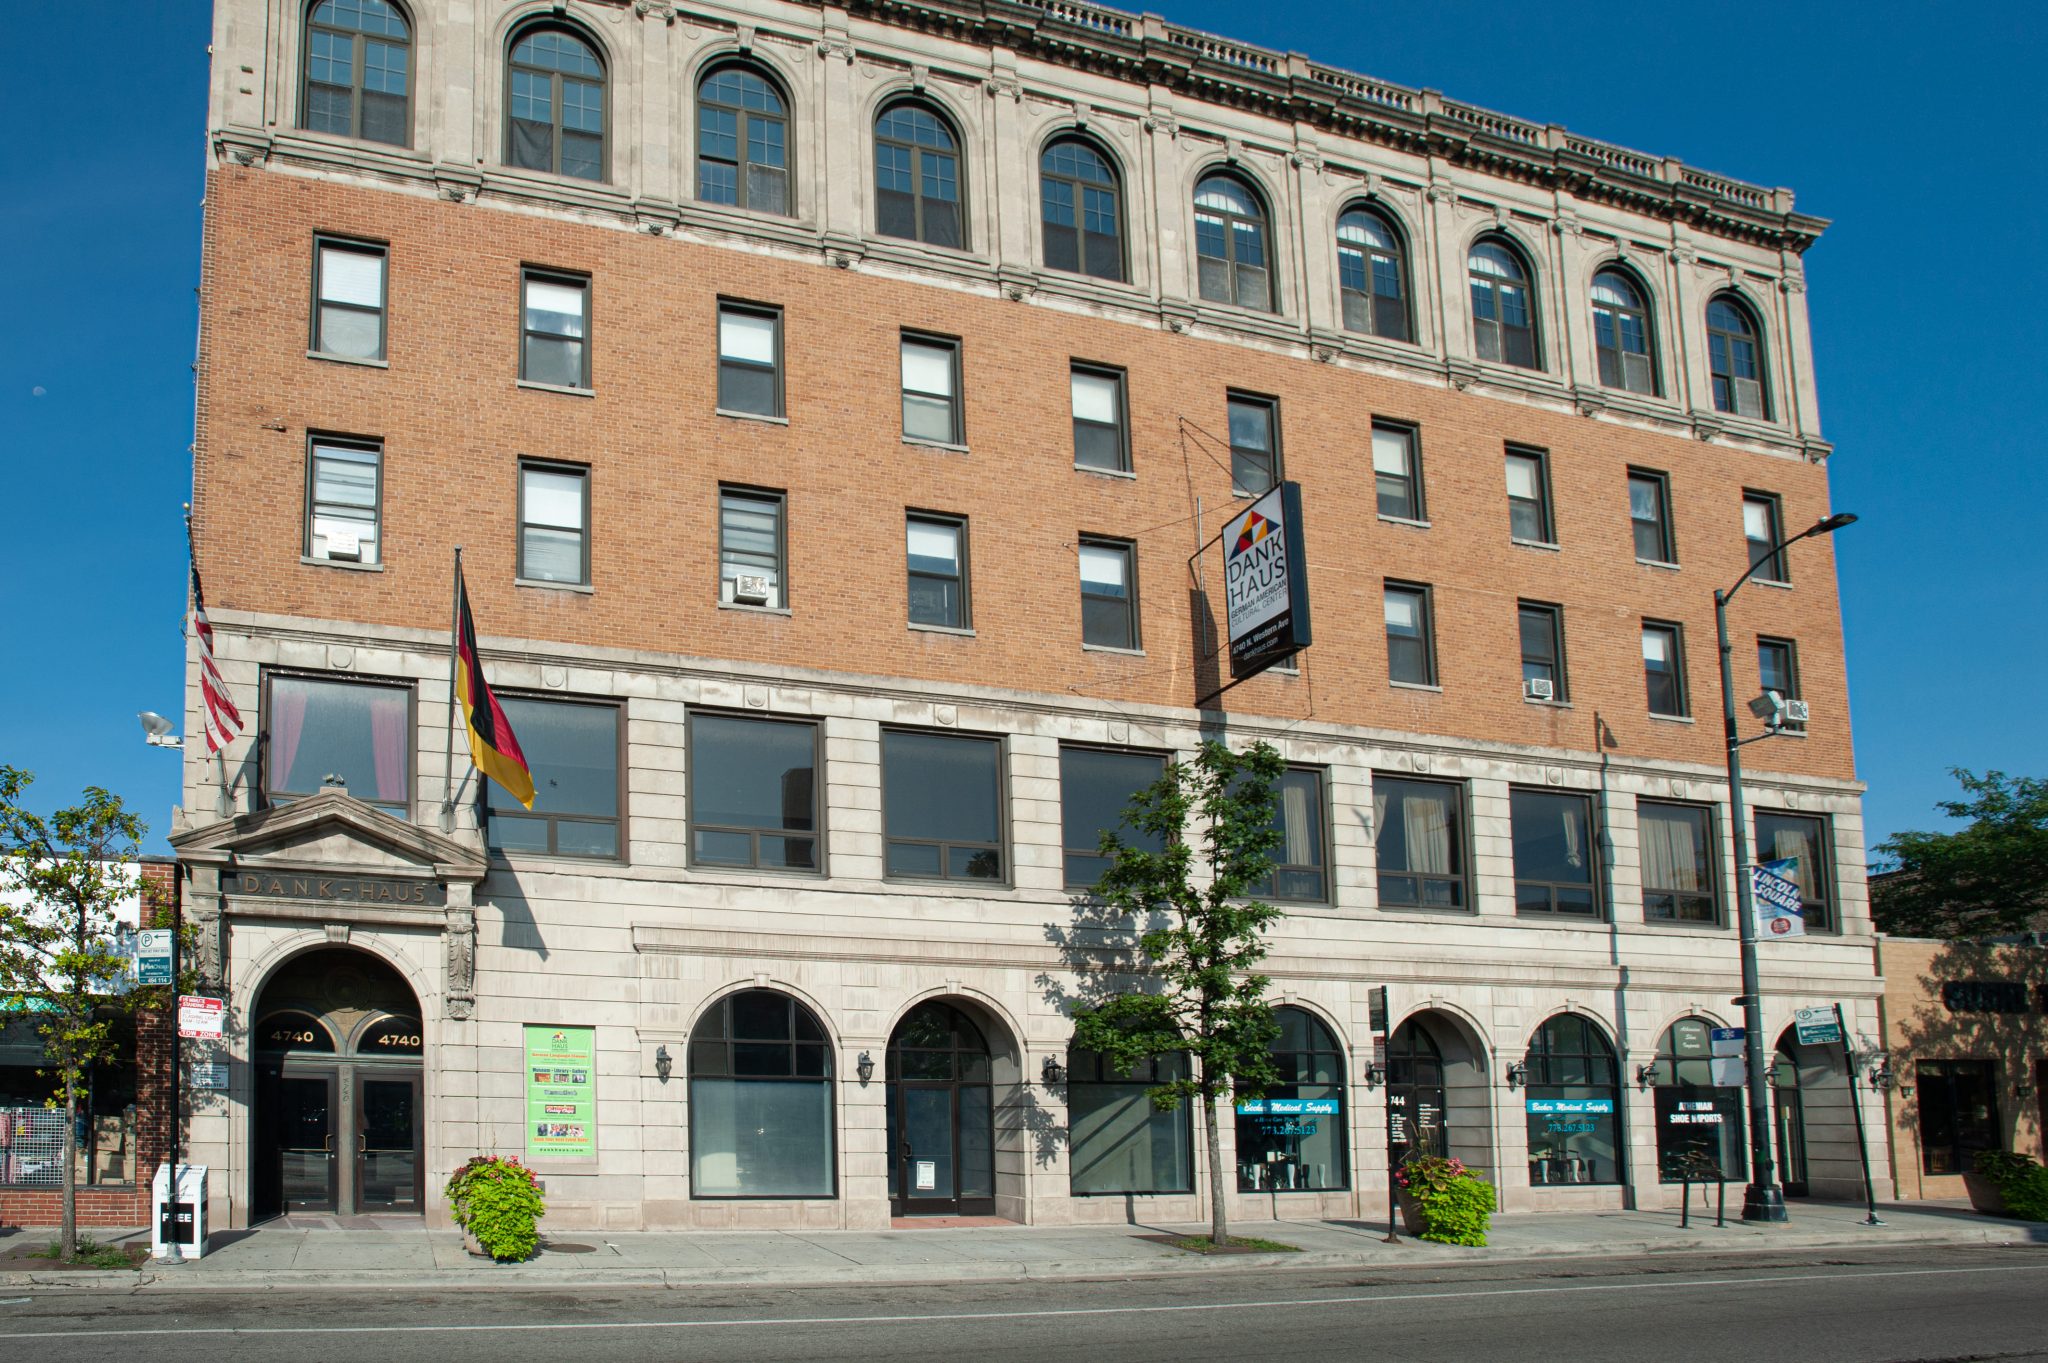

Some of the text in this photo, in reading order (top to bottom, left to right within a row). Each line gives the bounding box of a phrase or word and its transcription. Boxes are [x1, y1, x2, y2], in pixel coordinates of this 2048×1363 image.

[1228, 531, 1283, 584] DANK
[1230, 556, 1285, 607] HAUS
[1231, 578, 1287, 619] GERMAN AMERICAN
[1231, 587, 1287, 627] CULTURAL CENTER
[1232, 642, 1246, 655] 4740
[1253, 623, 1277, 642] Western
[1278, 618, 1289, 630] Ave
[1754, 870, 1800, 899] LINCOLN
[1755, 883, 1802, 912] SQUARE
[271, 1030, 314, 1043] 4740
[378, 1034, 421, 1046] 4740
[1271, 1102, 1302, 1112] Medical
[1305, 1102, 1332, 1113] Supply
[1532, 1102, 1609, 1113] Becker Medical Supply
[1678, 1101, 1713, 1111] ATHENIAN
[1670, 1113, 1722, 1123] SHOE IMPORTS
[1261, 1125, 1317, 1135] 773.267.5123
[1548, 1123, 1595, 1132] 773.267.5123
[162, 1212, 192, 1223] FEE
